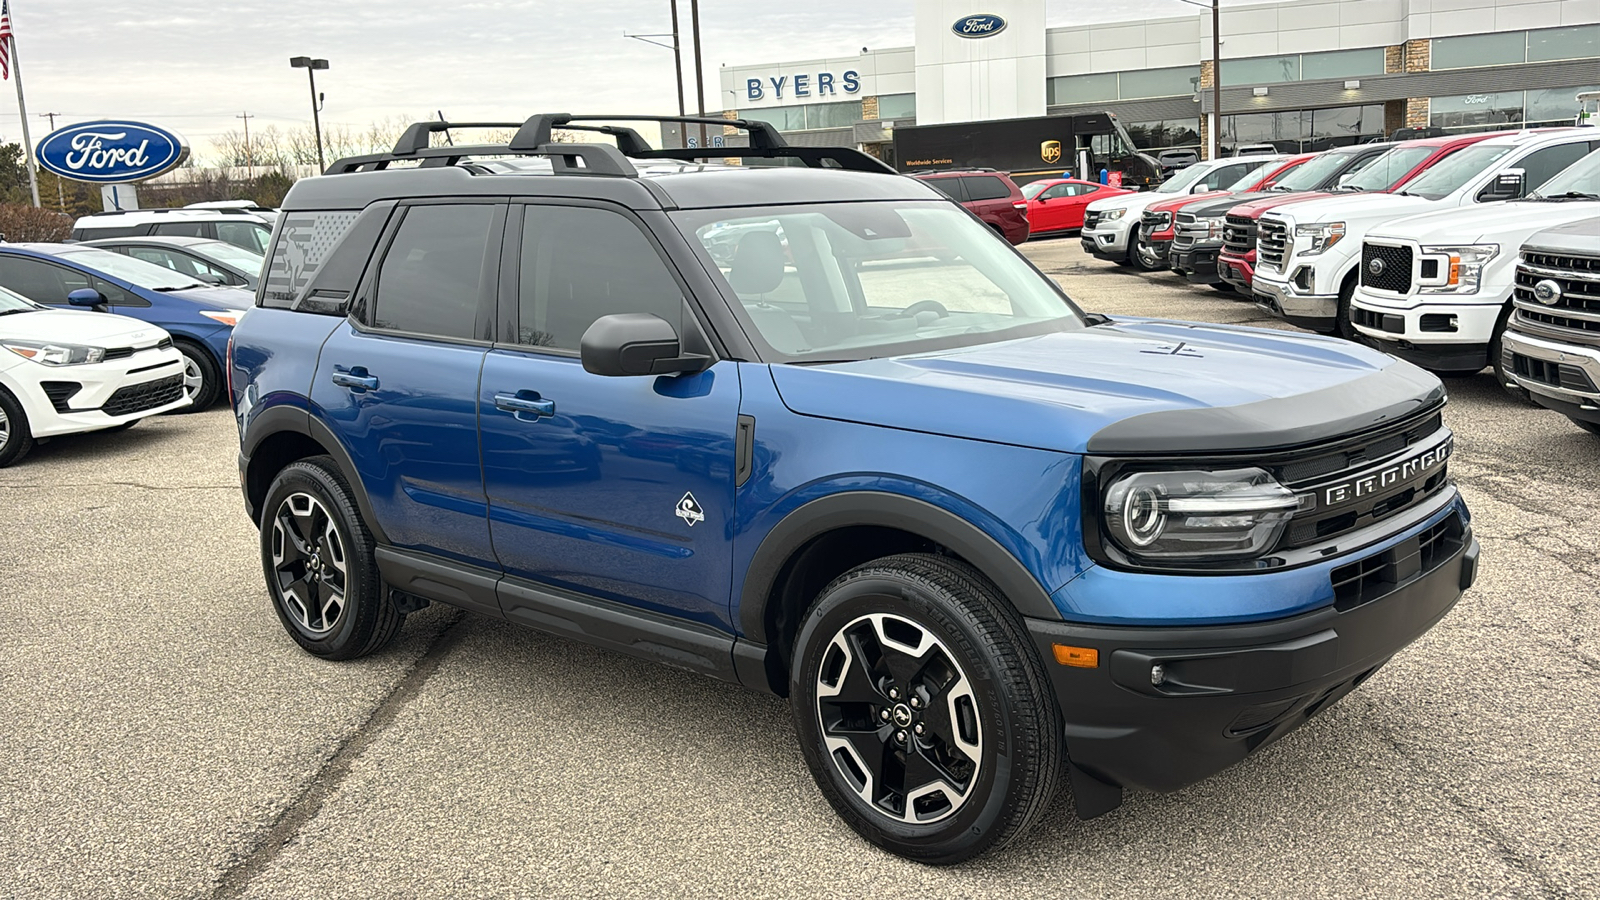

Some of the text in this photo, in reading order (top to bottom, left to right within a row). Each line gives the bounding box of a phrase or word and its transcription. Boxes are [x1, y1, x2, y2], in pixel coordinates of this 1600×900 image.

[963, 18, 994, 33] Ford
[746, 70, 861, 101] BYERS
[1464, 94, 1489, 104] Ford
[65, 132, 149, 170] Ford
[1043, 147, 1059, 160] ups
[1326, 442, 1450, 506] BRONCO
